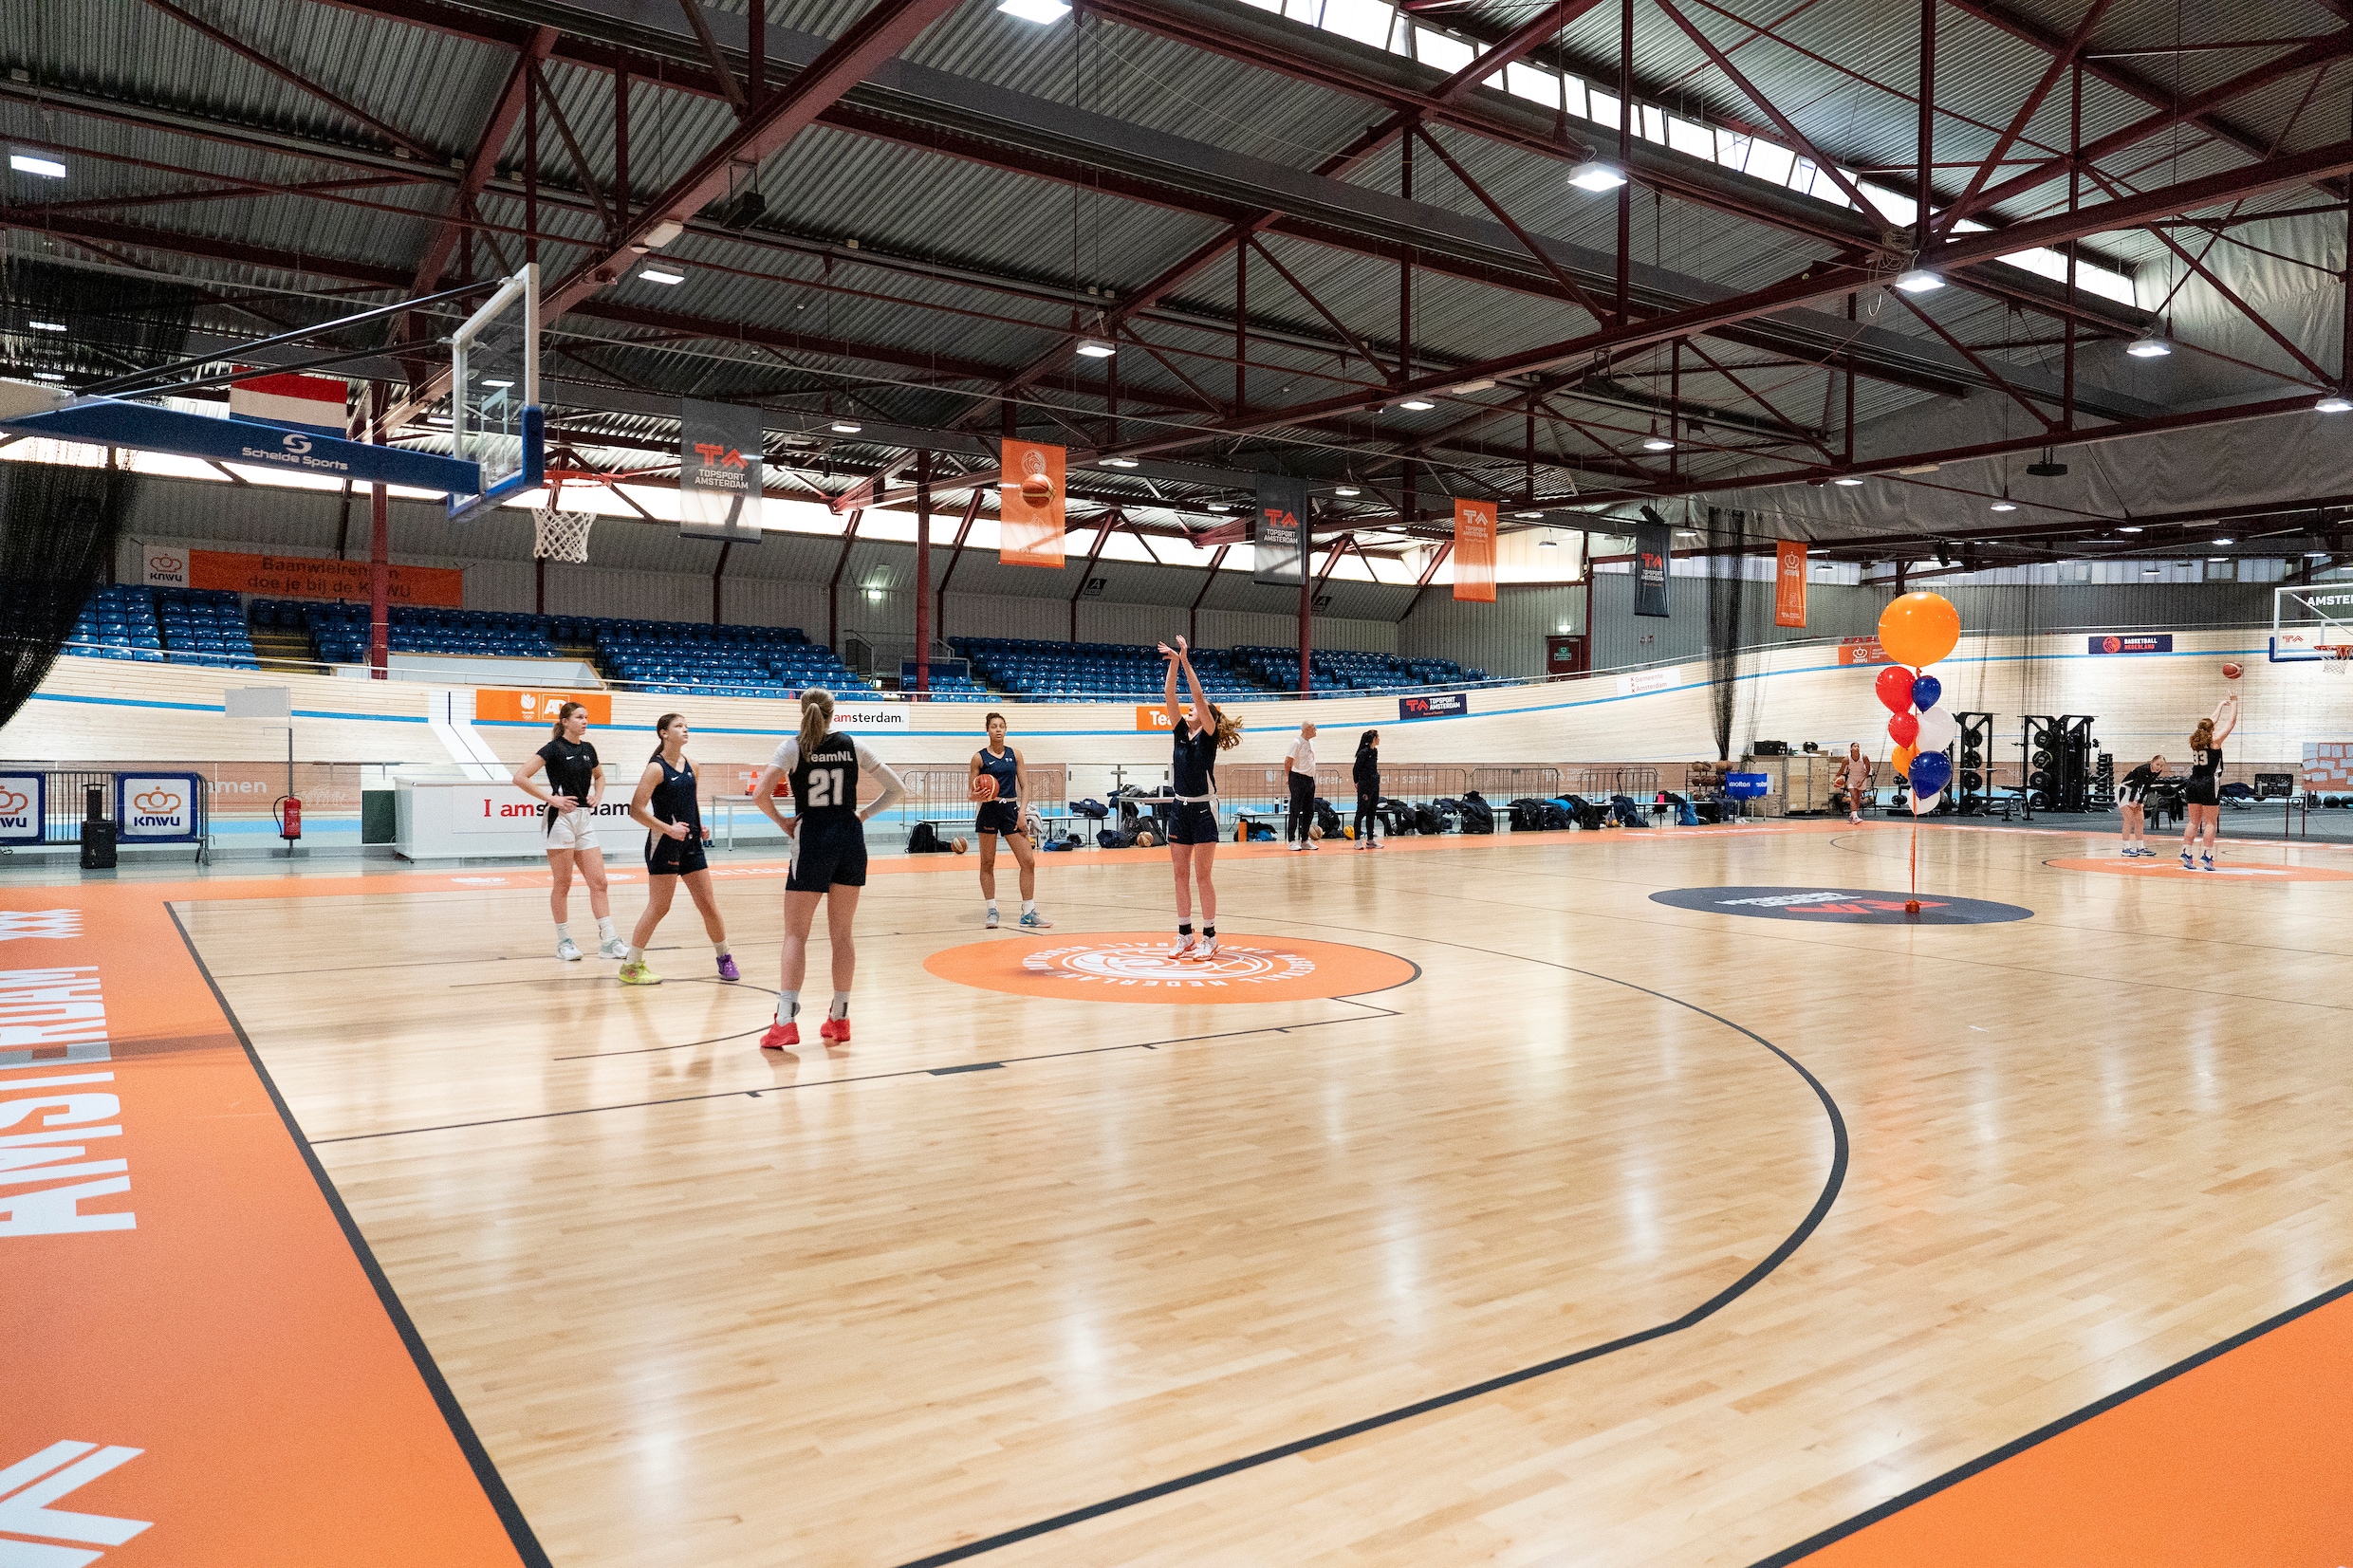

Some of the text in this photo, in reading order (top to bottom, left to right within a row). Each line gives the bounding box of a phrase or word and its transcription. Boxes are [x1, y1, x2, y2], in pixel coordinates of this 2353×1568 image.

[242, 446, 348, 470] Schelde Sports
[698, 469, 745, 481] TOPSPORT
[695, 476, 749, 489] AMSTERDAM
[1266, 528, 1296, 538] TOPSPORT
[1264, 535, 1298, 544] AMSTERDAM
[262, 556, 398, 580] Baanwielrenn
[358, 581, 412, 599] KWU
[2307, 595, 2353, 606] AMSTE
[1635, 673, 1664, 682] Gemeente
[1636, 682, 1668, 692] Amsterdam
[1429, 696, 1456, 705] TOPSPORT
[1429, 702, 1461, 710] AMSTERDAM
[810, 750, 854, 763] eamNL
[1401, 773, 1435, 784] samen
[807, 768, 844, 807] 21
[484, 799, 491, 817] I
